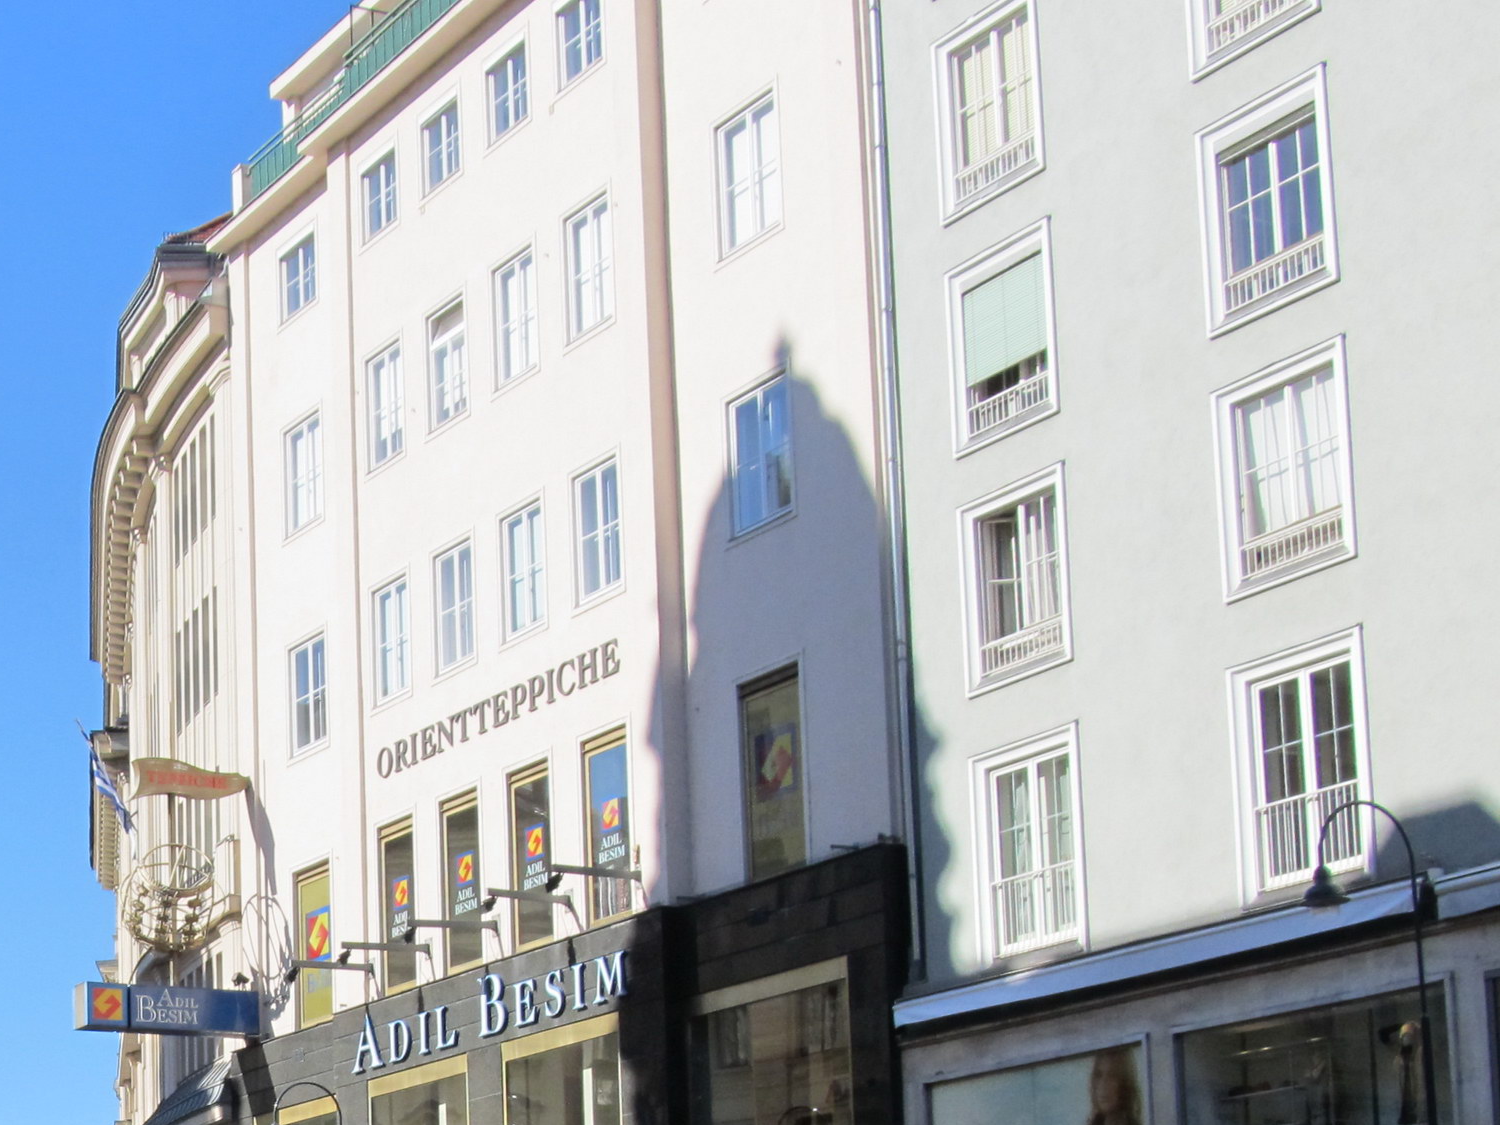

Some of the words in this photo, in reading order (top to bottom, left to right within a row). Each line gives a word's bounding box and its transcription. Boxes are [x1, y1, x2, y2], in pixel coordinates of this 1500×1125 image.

[376, 638, 621, 779] ORIENTTEPPICHE
[601, 833, 622, 851] ADIL
[598, 845, 626, 865] BESIM
[525, 860, 546, 878] ADIL
[523, 872, 549, 891] BESIM
[457, 887, 475, 903] ADIL
[454, 897, 478, 916] BESIM
[155, 988, 199, 1008] ADIL
[135, 994, 199, 1024] BESIM
[351, 1005, 460, 1075] ADIL
[477, 950, 629, 1039] BESIM
